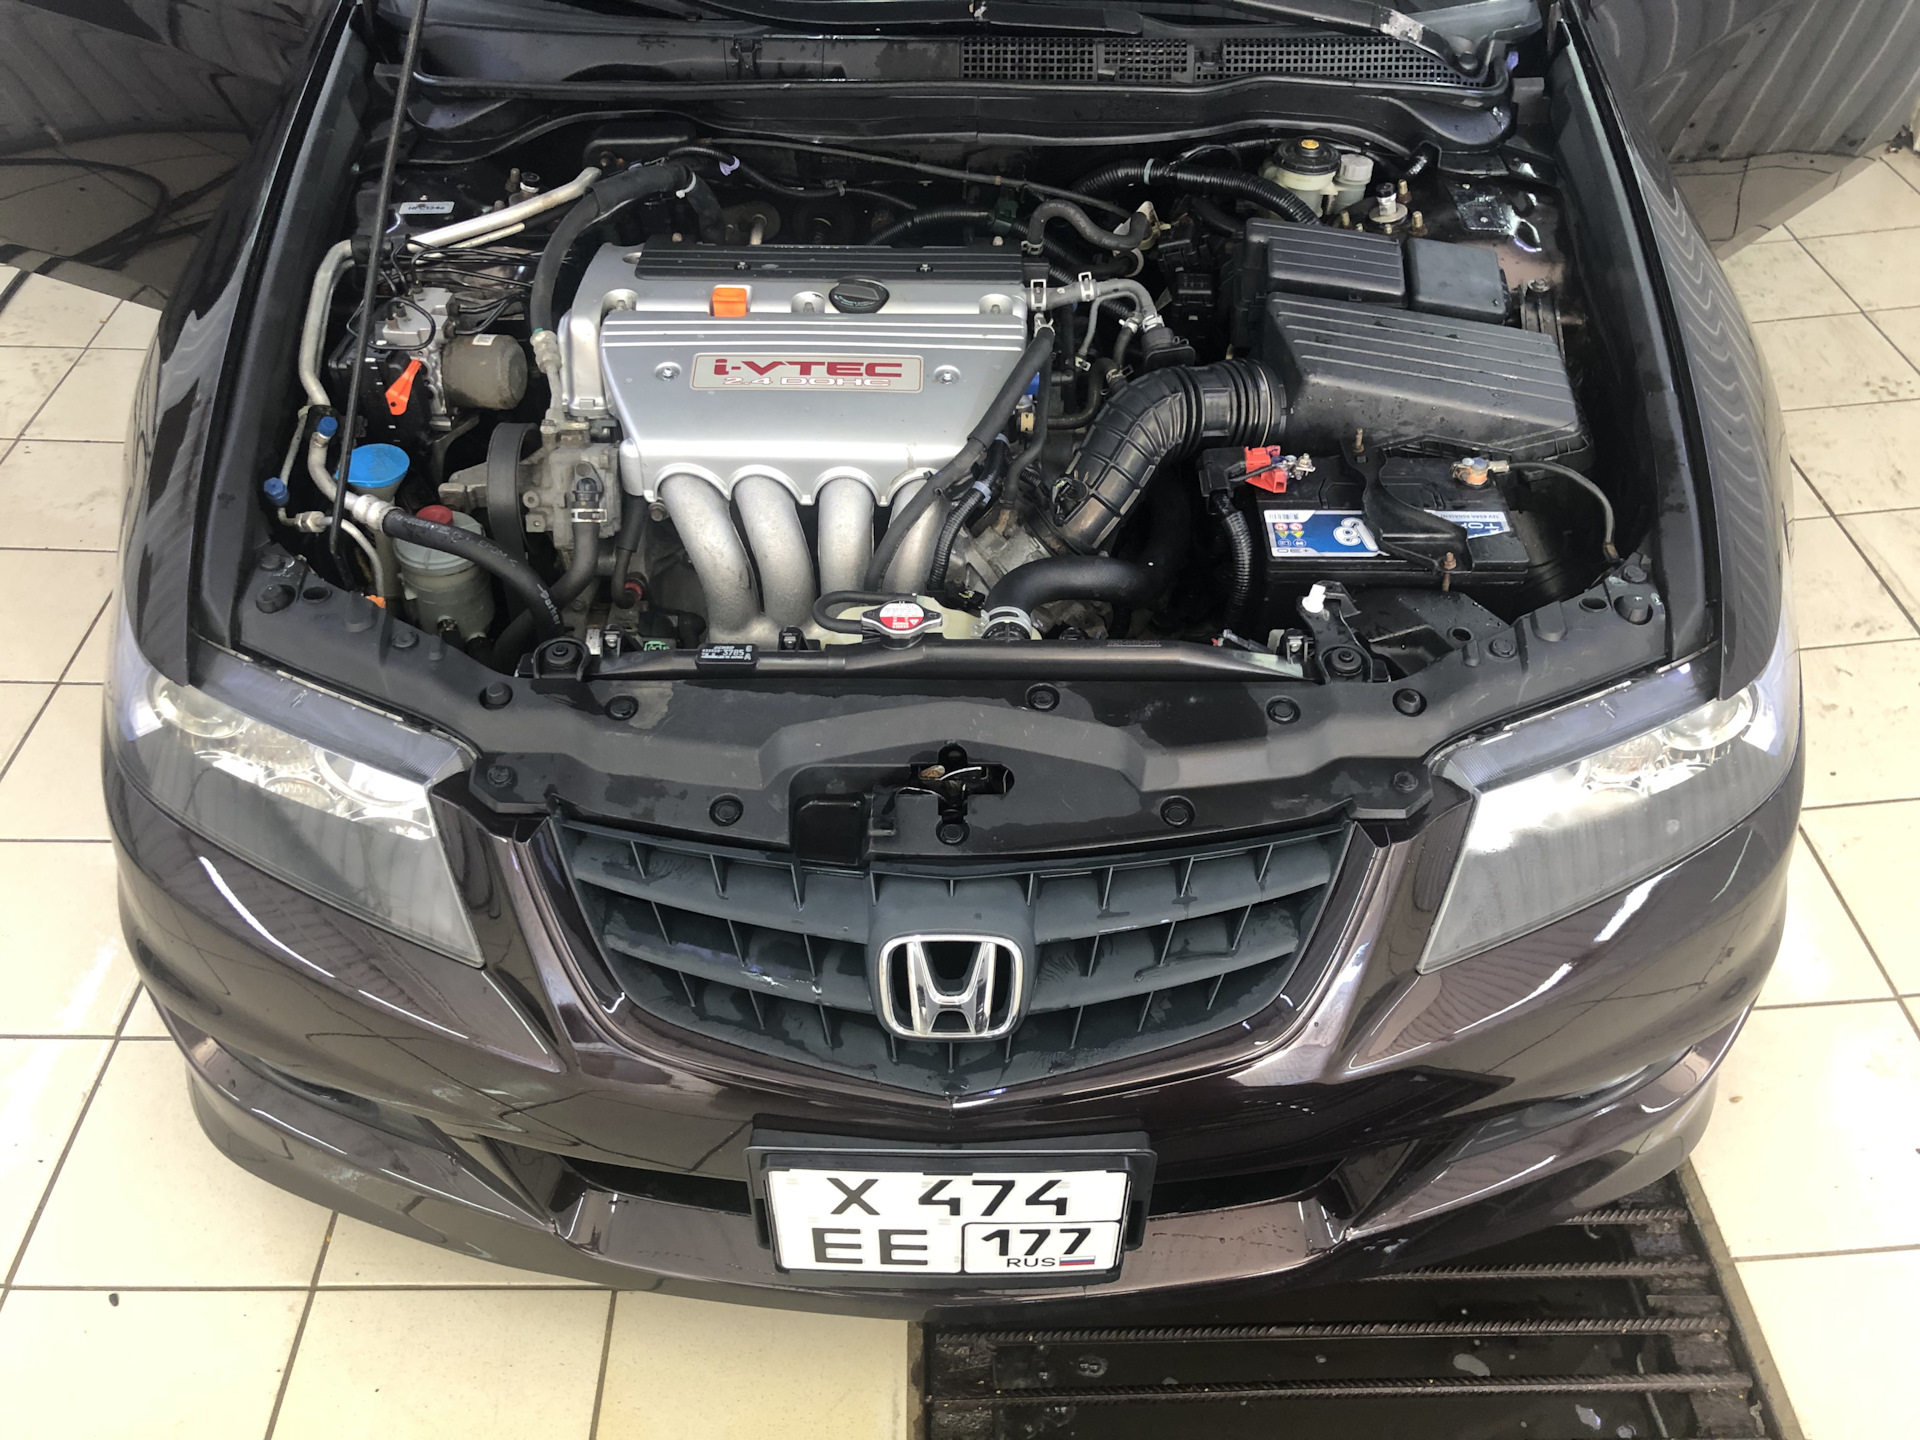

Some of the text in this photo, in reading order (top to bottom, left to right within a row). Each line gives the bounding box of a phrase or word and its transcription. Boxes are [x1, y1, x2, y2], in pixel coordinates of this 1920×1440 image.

[714, 358, 903, 378] i-VTEC
[723, 376, 891, 388] 2.4 DOHC
[538, 585, 560, 625] Parker
[918, 1179, 1069, 1216] 474
[812, 1227, 928, 1266] EE
[981, 1228, 1092, 1257] 177
[1006, 1257, 1056, 1268] RUS
